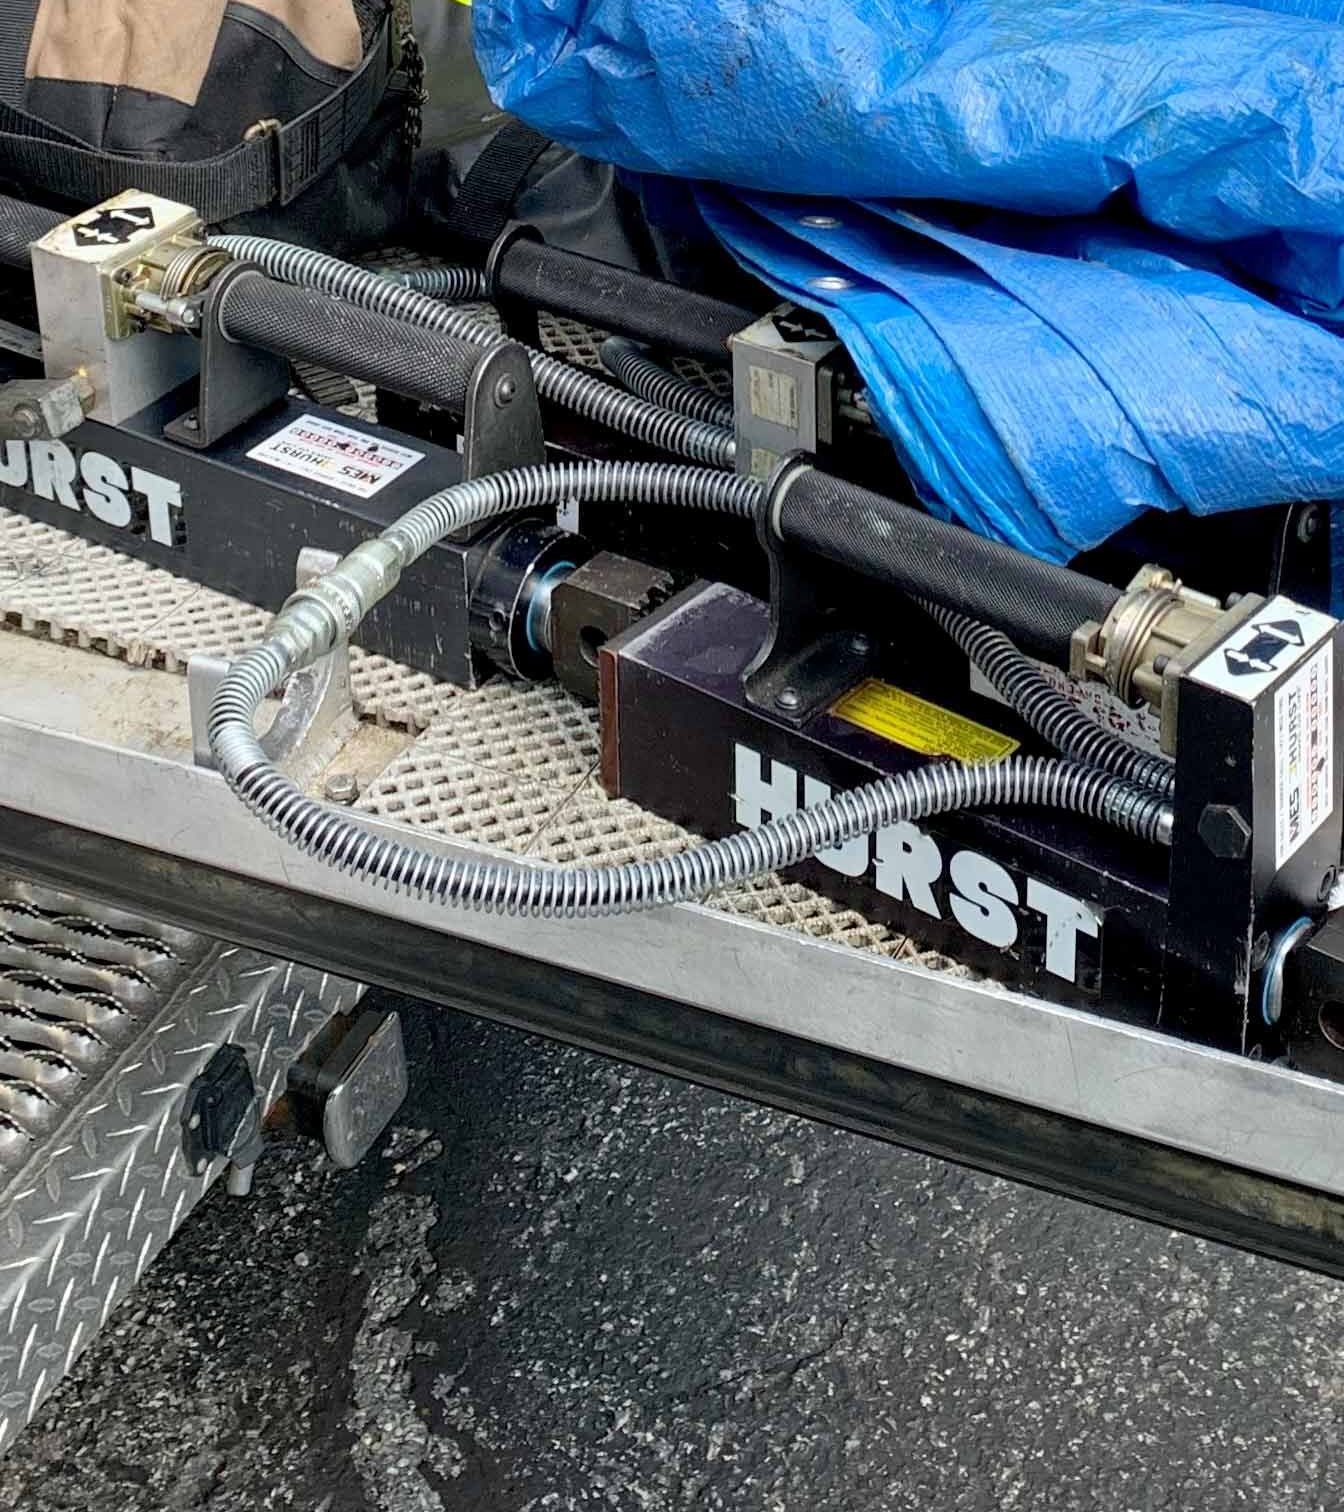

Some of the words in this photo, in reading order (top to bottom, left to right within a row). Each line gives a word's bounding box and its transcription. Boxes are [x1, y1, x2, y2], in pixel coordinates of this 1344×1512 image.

[269, 442, 323, 466] HURST
[336, 465, 383, 485] MES
[1288, 691, 1298, 766] HURST
[1289, 786, 1300, 843] MES
